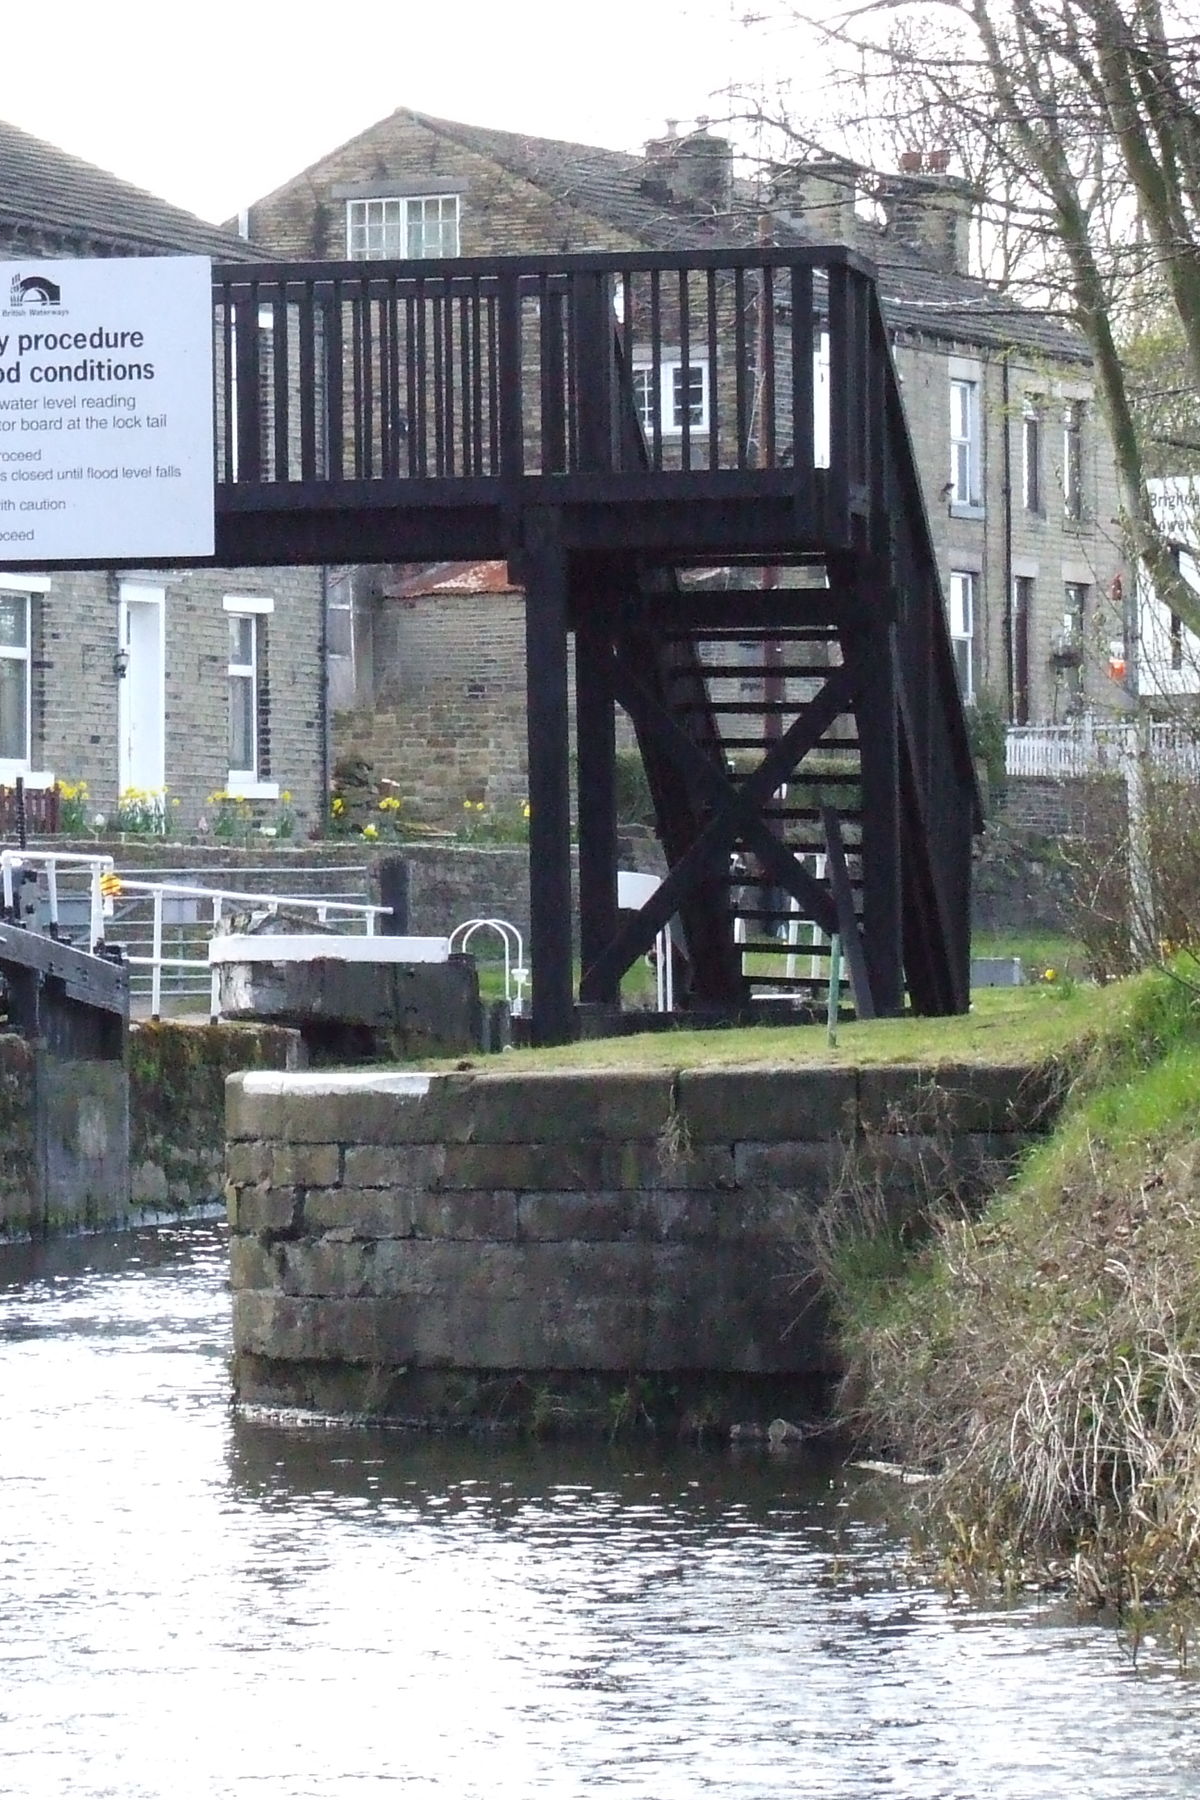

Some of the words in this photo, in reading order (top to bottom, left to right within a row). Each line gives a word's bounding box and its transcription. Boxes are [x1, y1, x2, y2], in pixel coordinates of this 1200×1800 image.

[18, 326, 144, 357] procedure
[29, 358, 155, 384] conditions
[42, 394, 77, 410] level
[81, 393, 137, 412] reading
[20, 416, 63, 432] board
[66, 416, 81, 431] at
[85, 415, 109, 430] the
[112, 414, 143, 430] lock
[145, 413, 167, 429] tail
[10, 468, 54, 482] closed
[56, 467, 84, 481] until
[86, 466, 119, 480] flood
[121, 465, 152, 479] level
[155, 465, 182, 478] falls
[19, 499, 67, 511] caution
